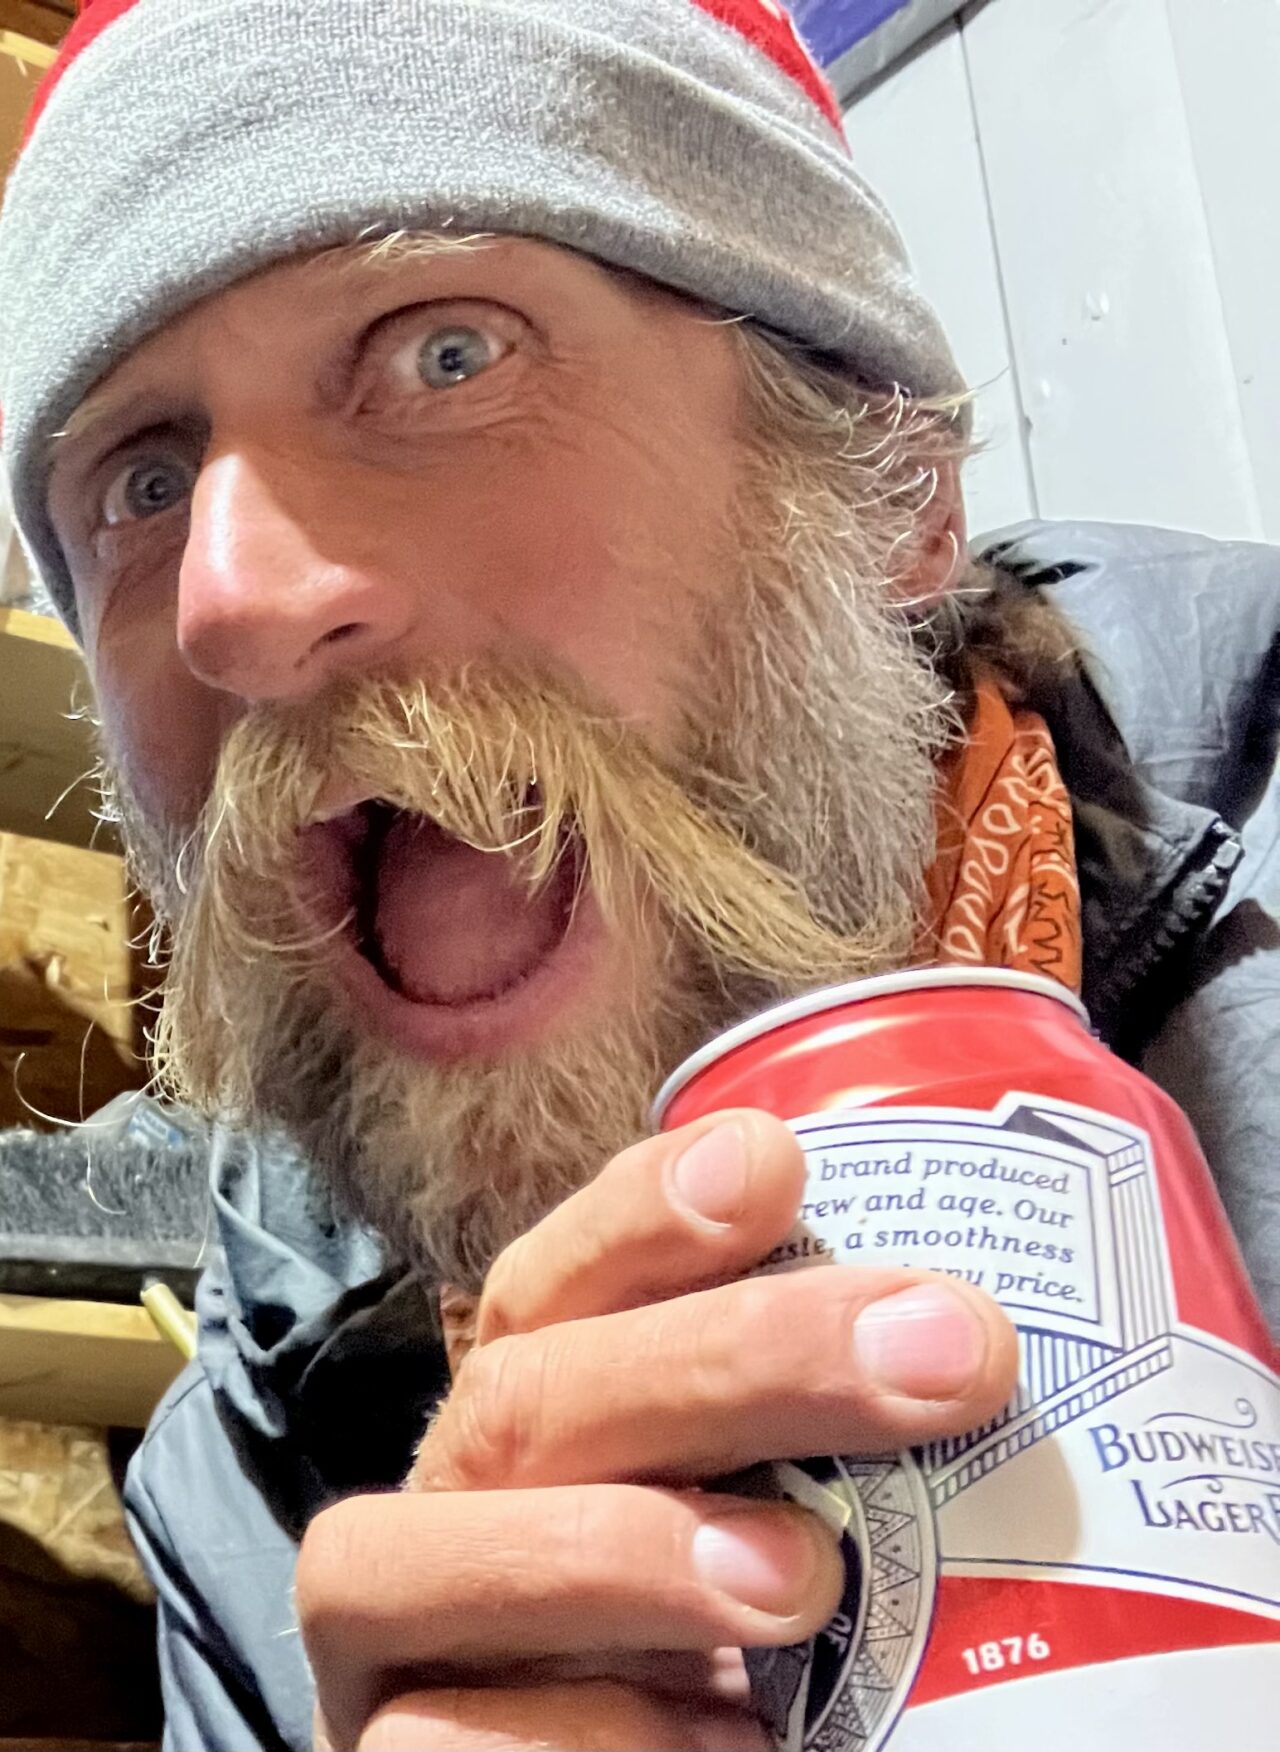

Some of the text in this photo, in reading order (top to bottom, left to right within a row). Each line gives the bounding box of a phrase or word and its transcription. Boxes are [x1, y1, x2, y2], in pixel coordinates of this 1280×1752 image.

[820, 1152, 1071, 1195] brand produced
[800, 1187, 1074, 1229] rew and age. Our
[845, 1232, 864, 1250] a
[874, 1226, 1075, 1264] smoothness
[993, 1271, 1085, 1303] price.
[1130, 1479, 1276, 1540] LAGER
[961, 1632, 1051, 1675] 1876
